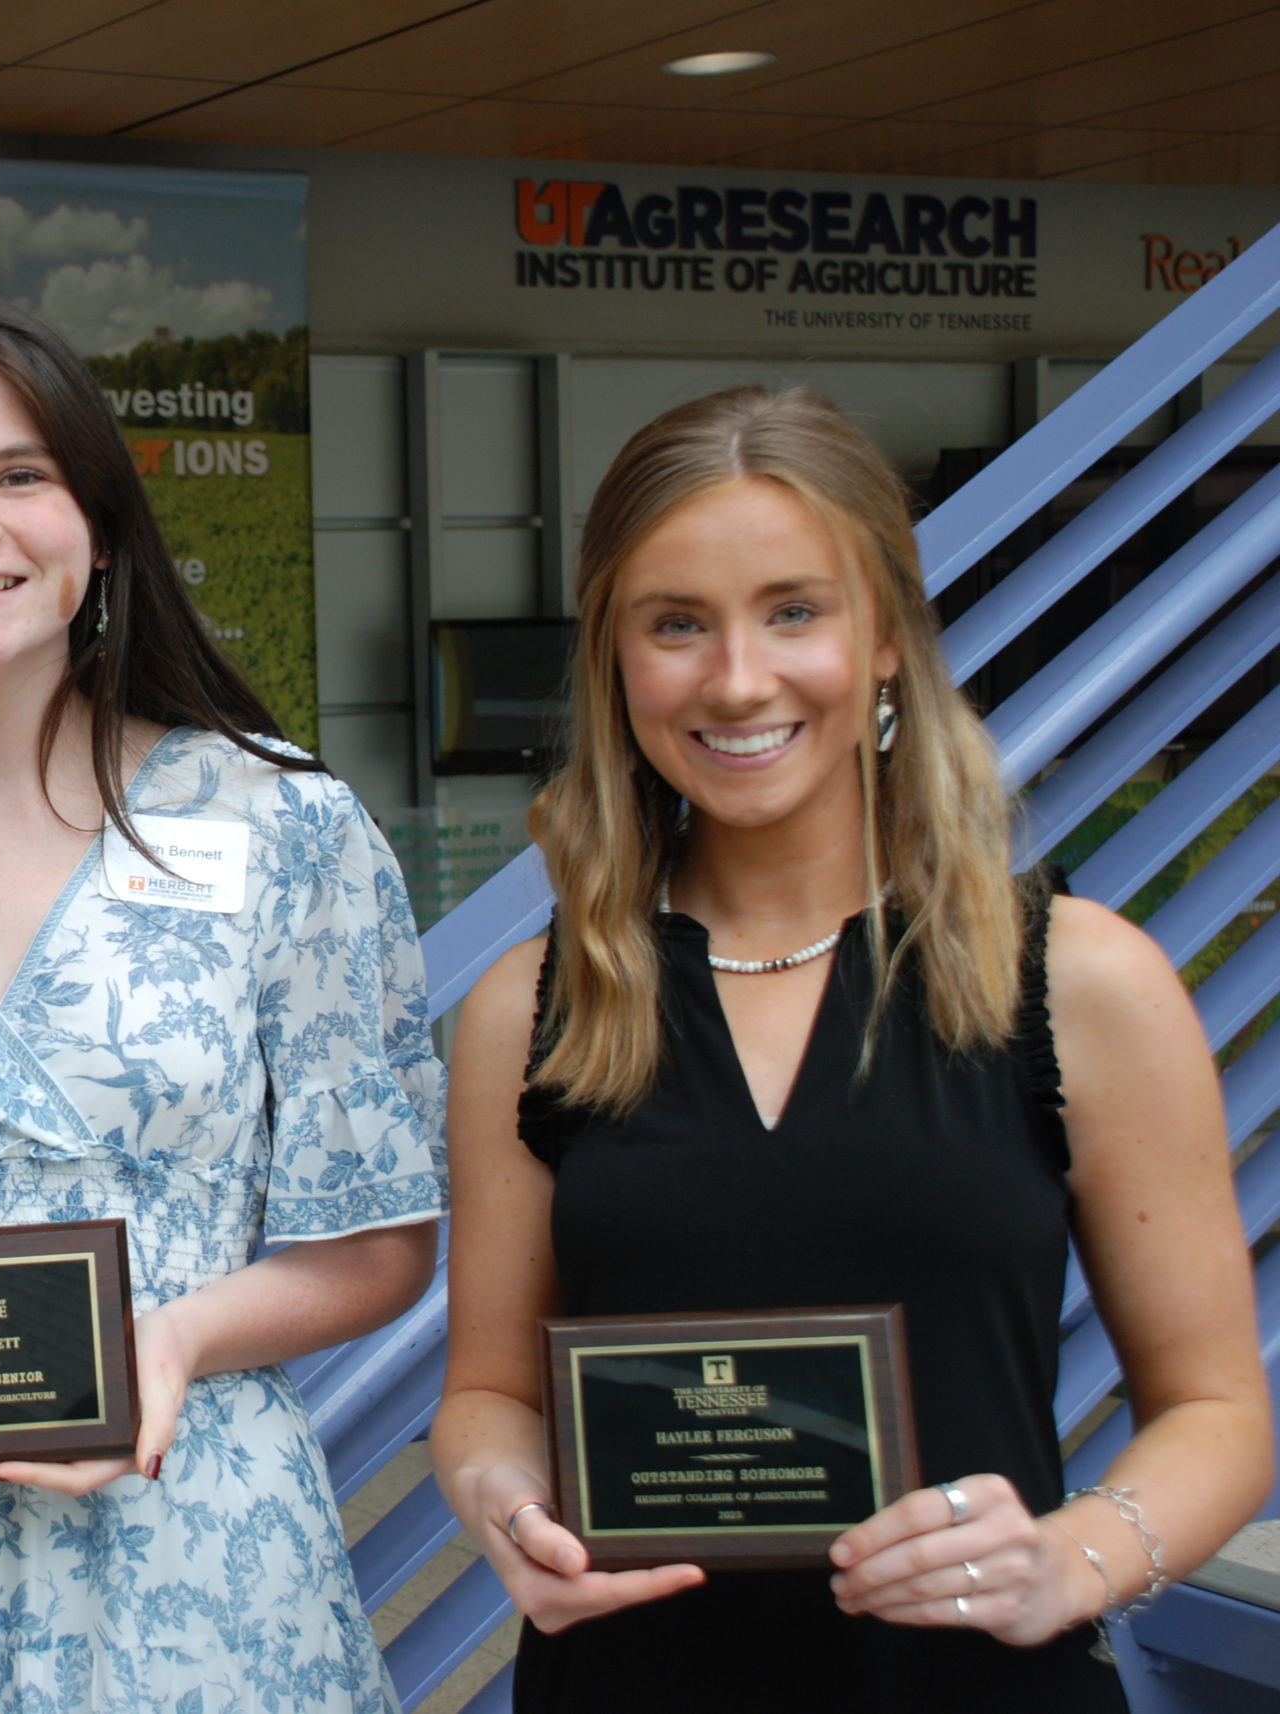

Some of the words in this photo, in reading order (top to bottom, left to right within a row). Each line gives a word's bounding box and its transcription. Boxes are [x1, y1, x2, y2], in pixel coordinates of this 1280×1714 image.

[515, 251, 715, 292] INSTITUTE
[724, 256, 778, 293] OF
[787, 259, 1037, 298] AGRICULTURE
[765, 308, 799, 328] THE
[803, 310, 905, 330] UNIVERSITY
[908, 311, 934, 330] OF
[936, 312, 1033, 332] TENNESSEE
[103, 381, 255, 426] vesting
[437, 824, 464, 839] we
[469, 822, 501, 837] are
[169, 845, 222, 861] Bennett
[148, 878, 214, 894] HERBERT
[707, 1359, 728, 1380] T
[674, 1387, 693, 1395] THE
[695, 1385, 751, 1395] UNIVERSITY
[753, 1385, 766, 1393] OF
[673, 1392, 768, 1410] TENNESSEE
[695, 1407, 749, 1417] KNOXVILLE
[656, 1430, 712, 1445] HAYLEE
[716, 1427, 794, 1443] FERGUSON
[631, 1469, 733, 1484] OUTSTANDING
[739, 1467, 826, 1481] SOPHOMORE
[635, 1494, 682, 1505] HERBERT
[685, 1492, 733, 1503] COLLEGE
[735, 1491, 750, 1501] OF
[754, 1490, 826, 1502] AGRICULTURE
[718, 1510, 743, 1520] 2023
